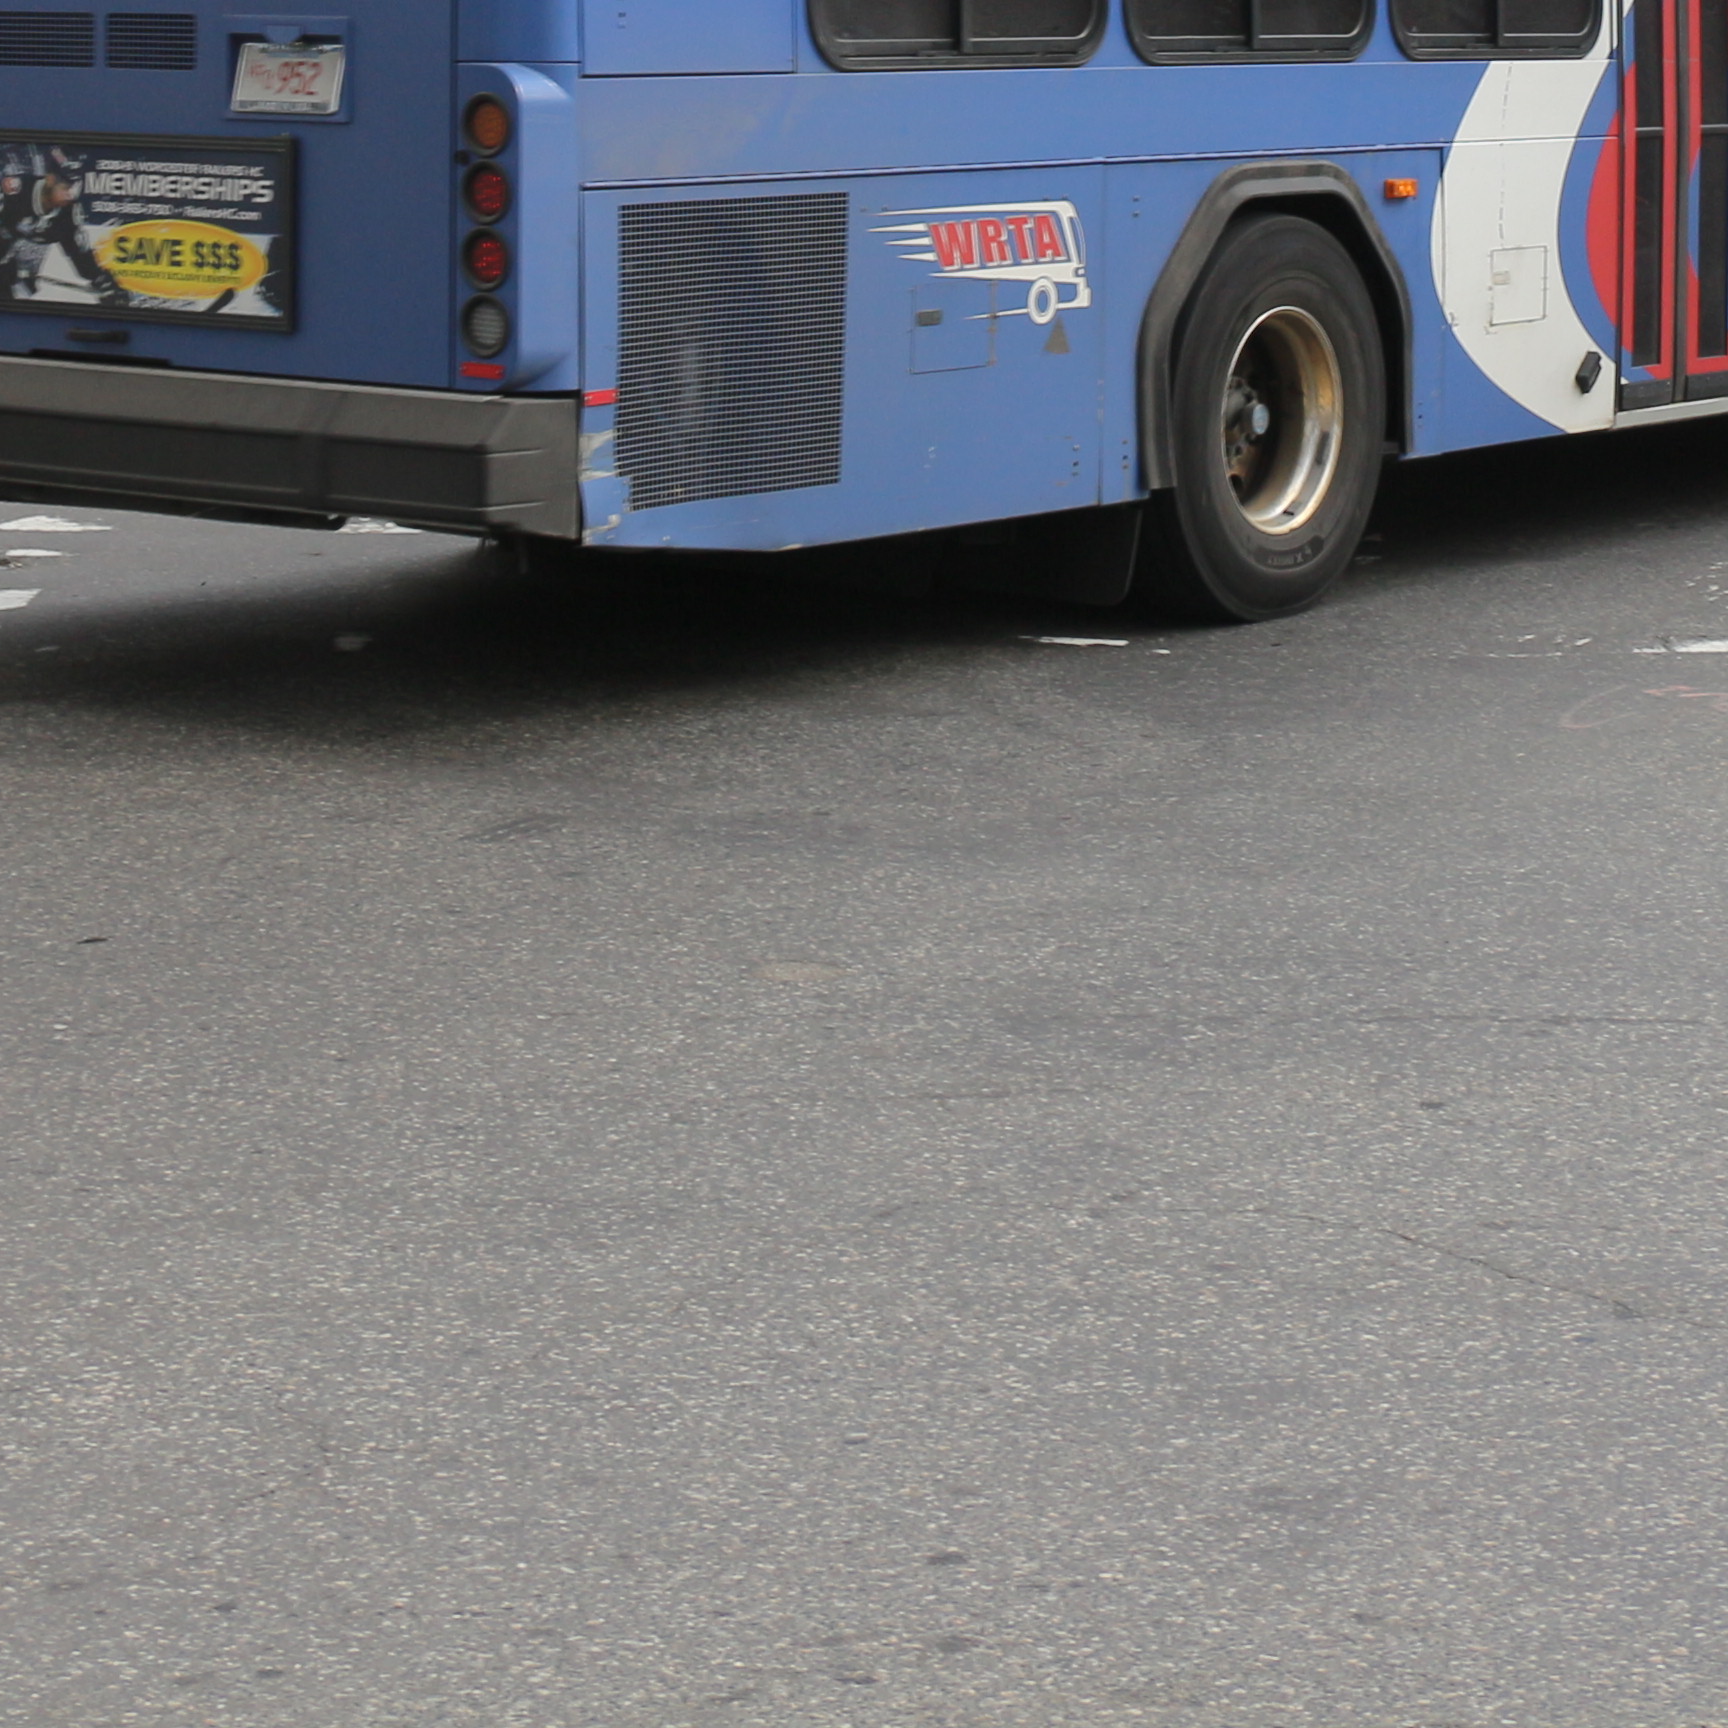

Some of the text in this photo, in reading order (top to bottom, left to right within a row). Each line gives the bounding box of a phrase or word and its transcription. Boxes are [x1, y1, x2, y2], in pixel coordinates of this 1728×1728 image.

[84, 171, 275, 203] MEMBERSHIPS
[113, 235, 186, 267] SAVE
[927, 214, 1070, 271] WRTA
